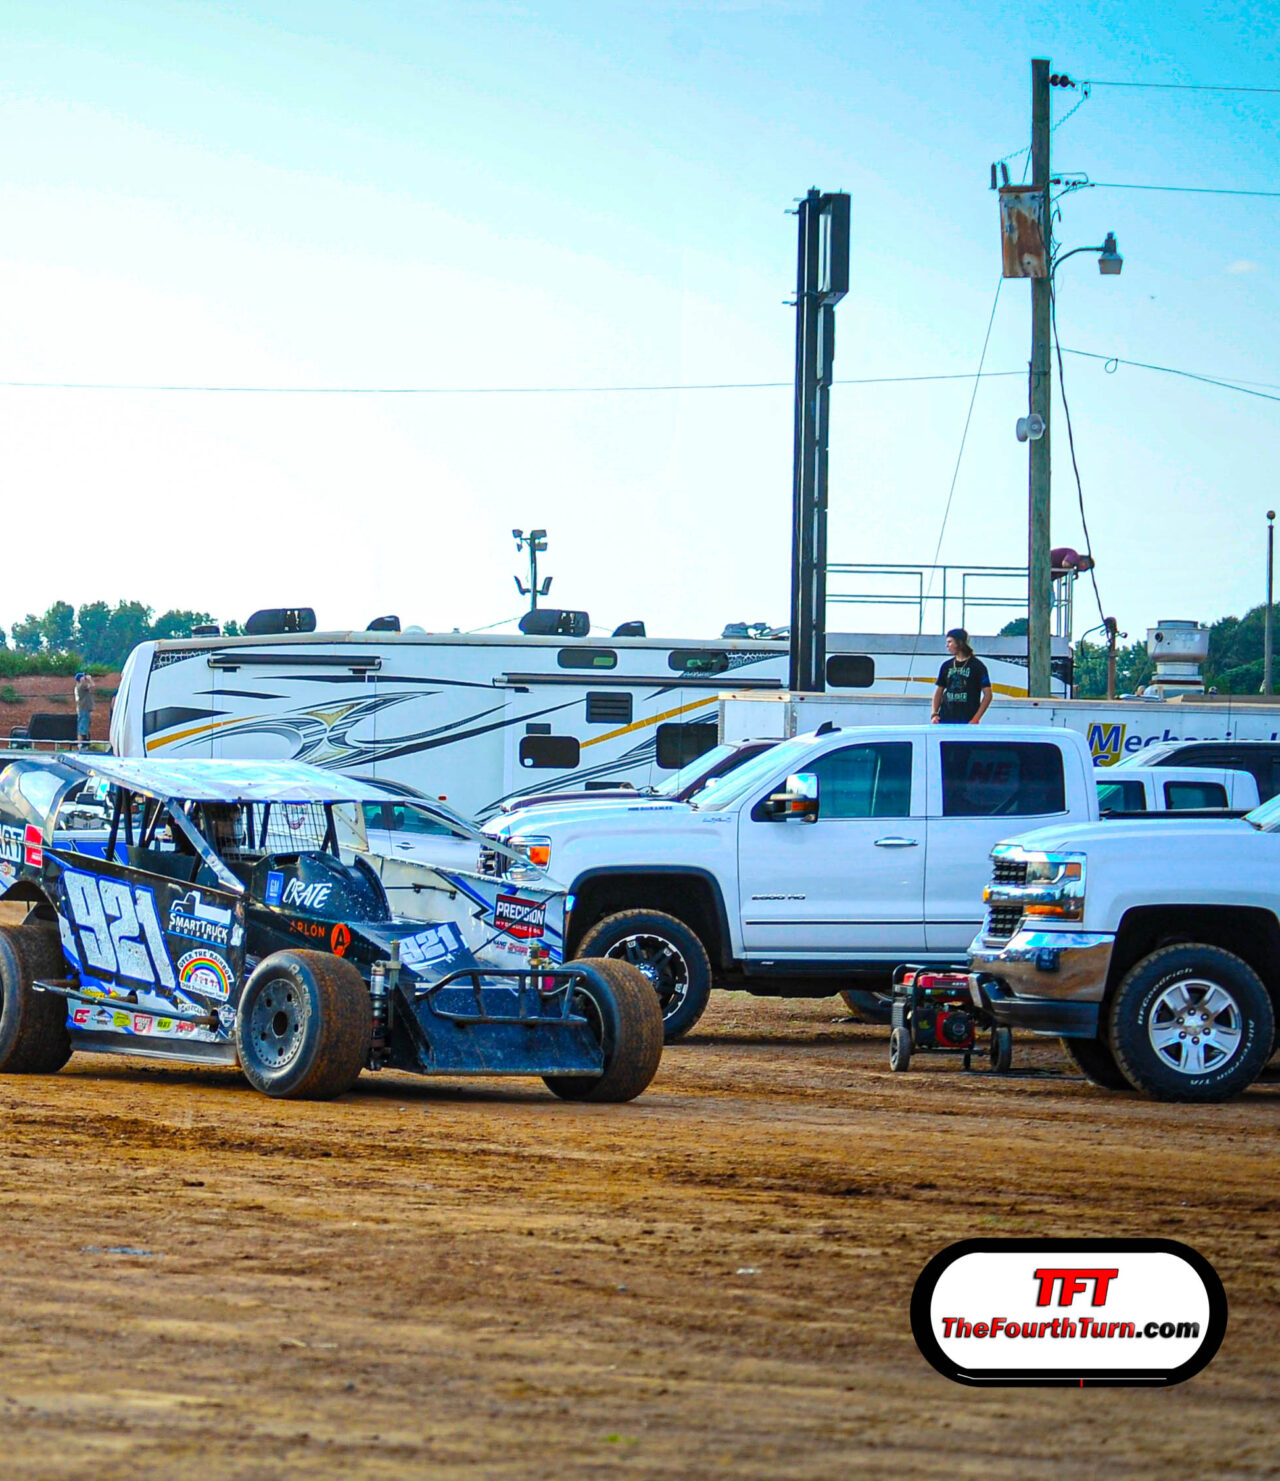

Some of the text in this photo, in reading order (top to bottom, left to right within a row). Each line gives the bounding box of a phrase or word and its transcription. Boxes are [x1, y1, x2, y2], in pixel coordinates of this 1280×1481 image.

[282, 877, 332, 908] CRATE
[63, 870, 177, 989] 921
[496, 901, 545, 925] PRECISION
[399, 924, 459, 964] 921
